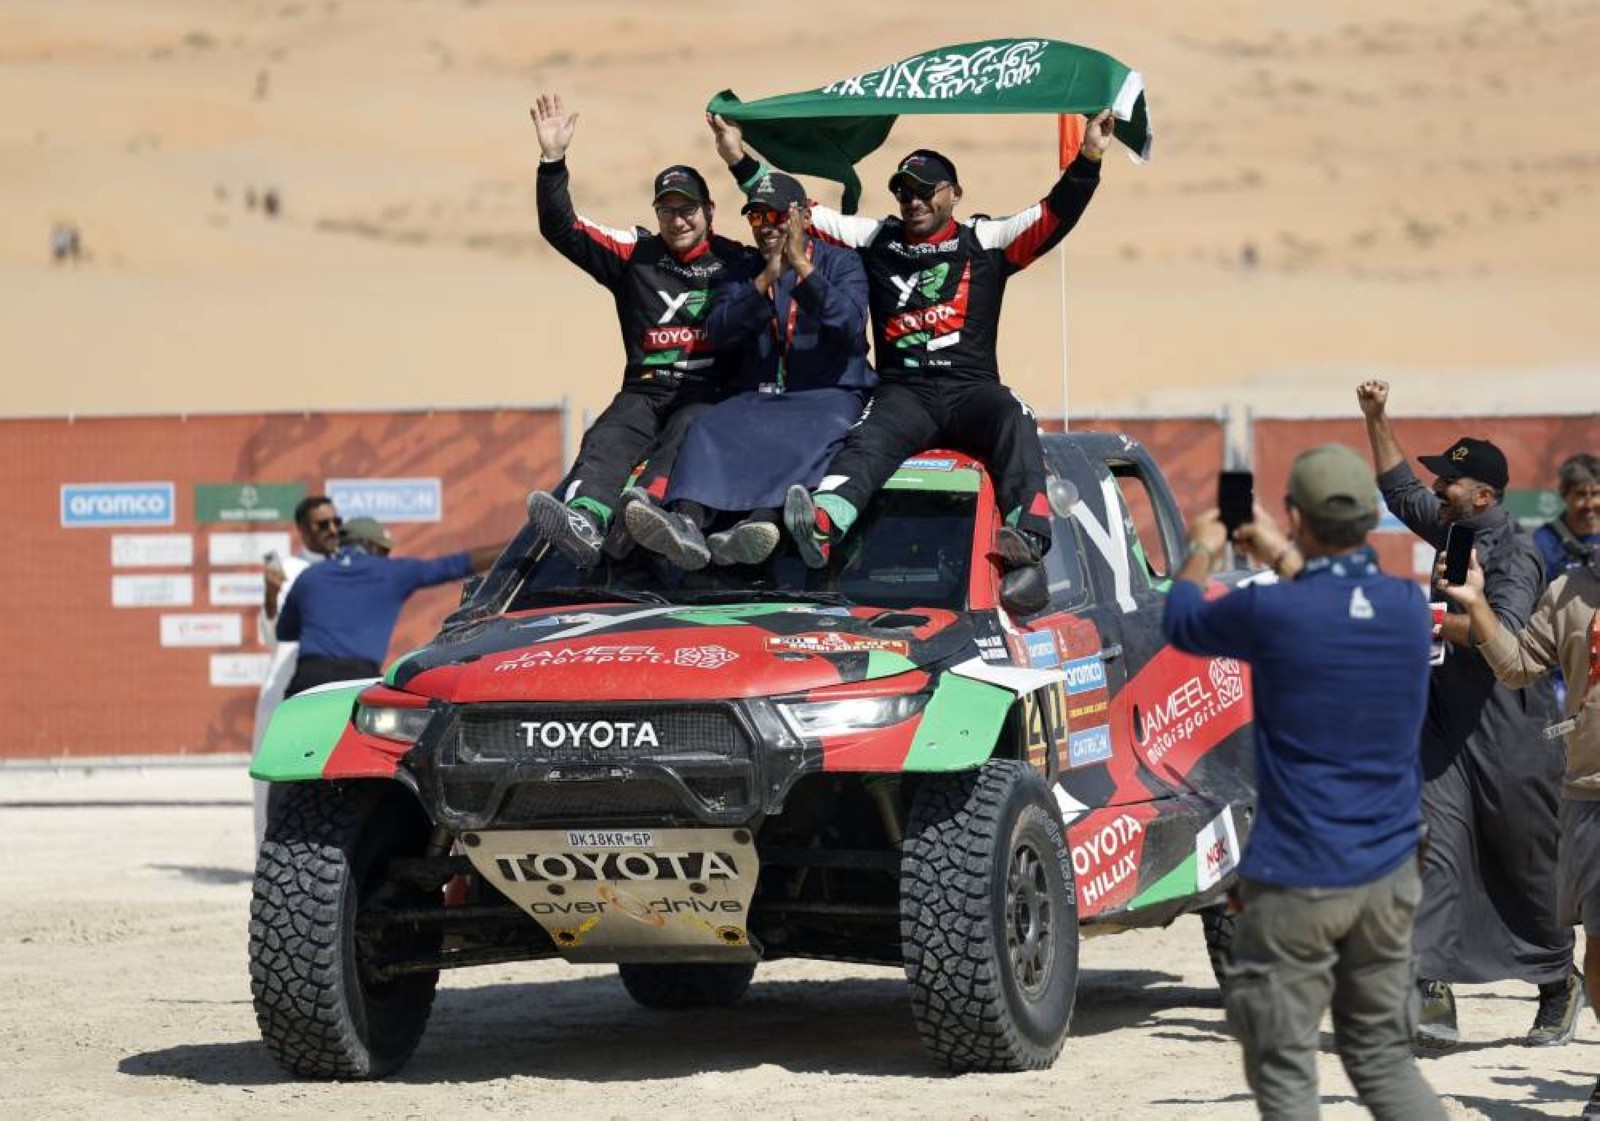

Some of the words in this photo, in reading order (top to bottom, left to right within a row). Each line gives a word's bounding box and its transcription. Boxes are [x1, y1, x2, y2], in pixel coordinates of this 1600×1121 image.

[649, 328, 706, 345] TOYOT
[71, 494, 165, 515] aramco
[517, 645, 664, 662] JAMEEL
[1140, 676, 1212, 748] JAMEEL
[520, 721, 659, 748] TOYOTA
[1071, 813, 1142, 876] OYOTA
[496, 851, 740, 883] TOYOTA
[1082, 850, 1137, 906] HILUX
[530, 901, 608, 914] over
[650, 896, 743, 913] drive
